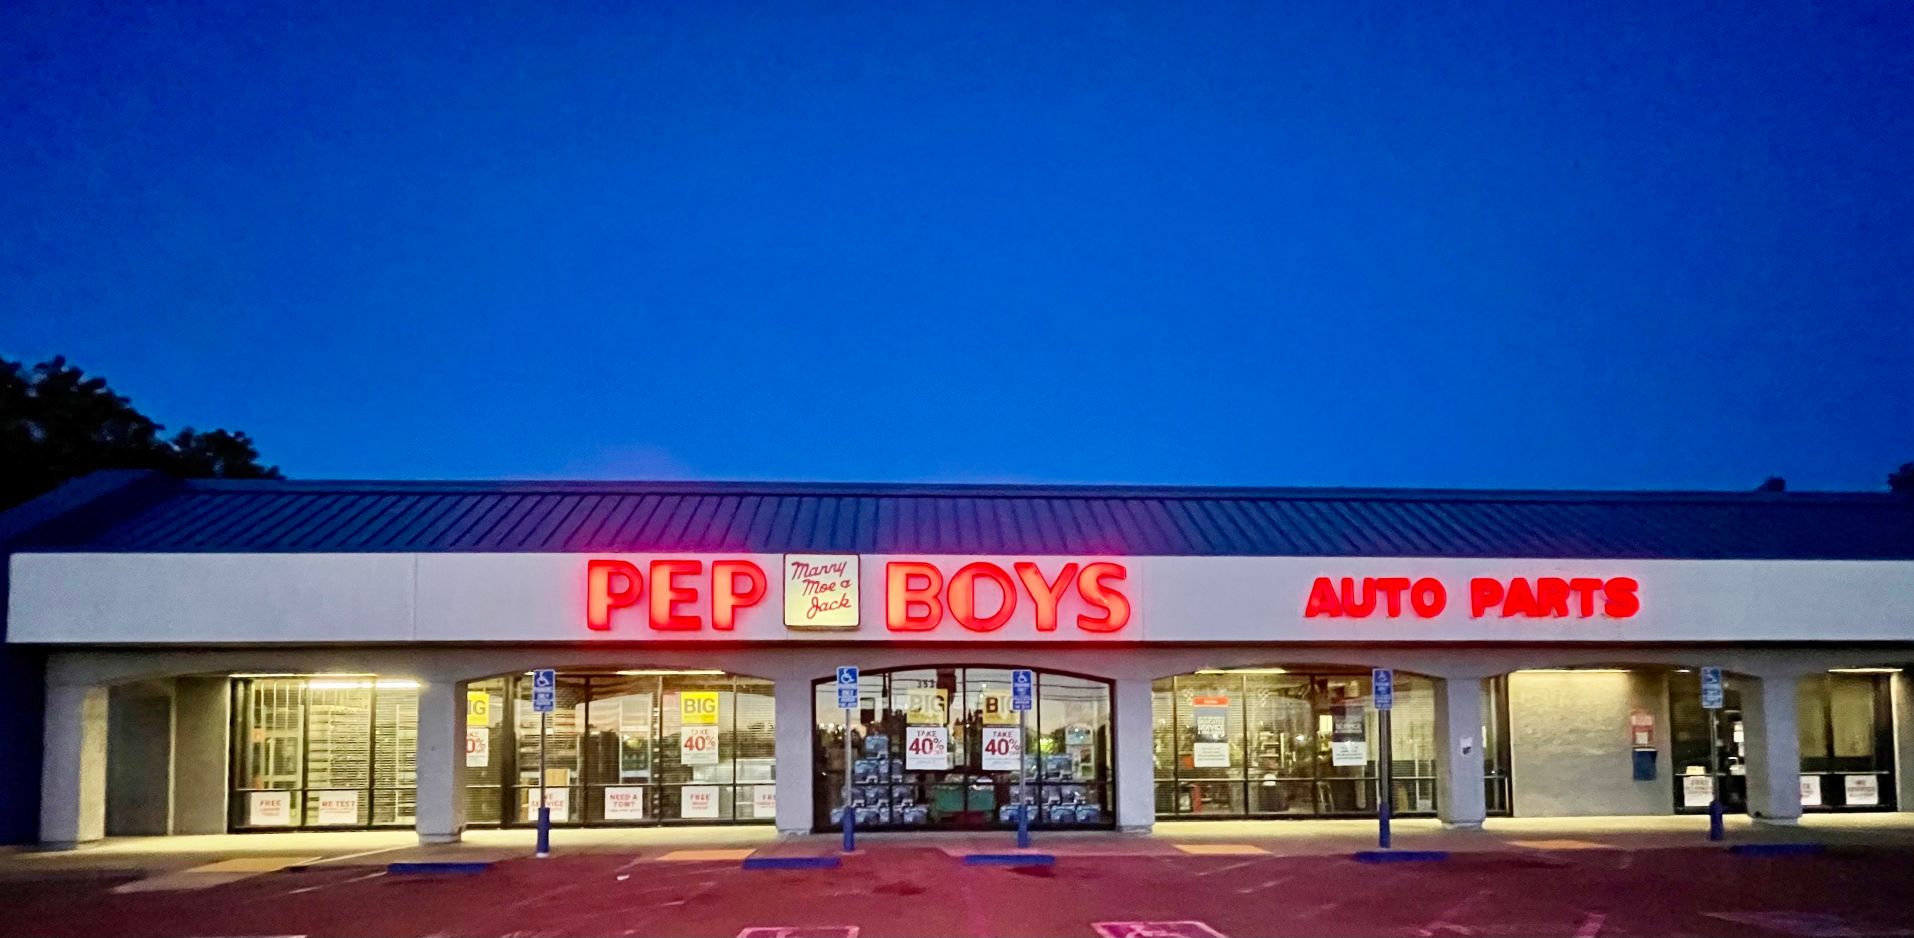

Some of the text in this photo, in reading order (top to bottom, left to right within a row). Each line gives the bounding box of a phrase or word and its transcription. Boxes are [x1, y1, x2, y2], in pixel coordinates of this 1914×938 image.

[791, 561, 847, 580] Manny
[587, 560, 1131, 633] PEP BOYS
[802, 579, 836, 596] Moe
[807, 592, 852, 619] Jack
[1304, 576, 1640, 618] AUTO PARTS
[467, 699, 487, 715] IG
[684, 698, 716, 714] BIG
[684, 734, 716, 751] 40%
[909, 737, 945, 755] 40%
[985, 738, 1020, 756] 40%
